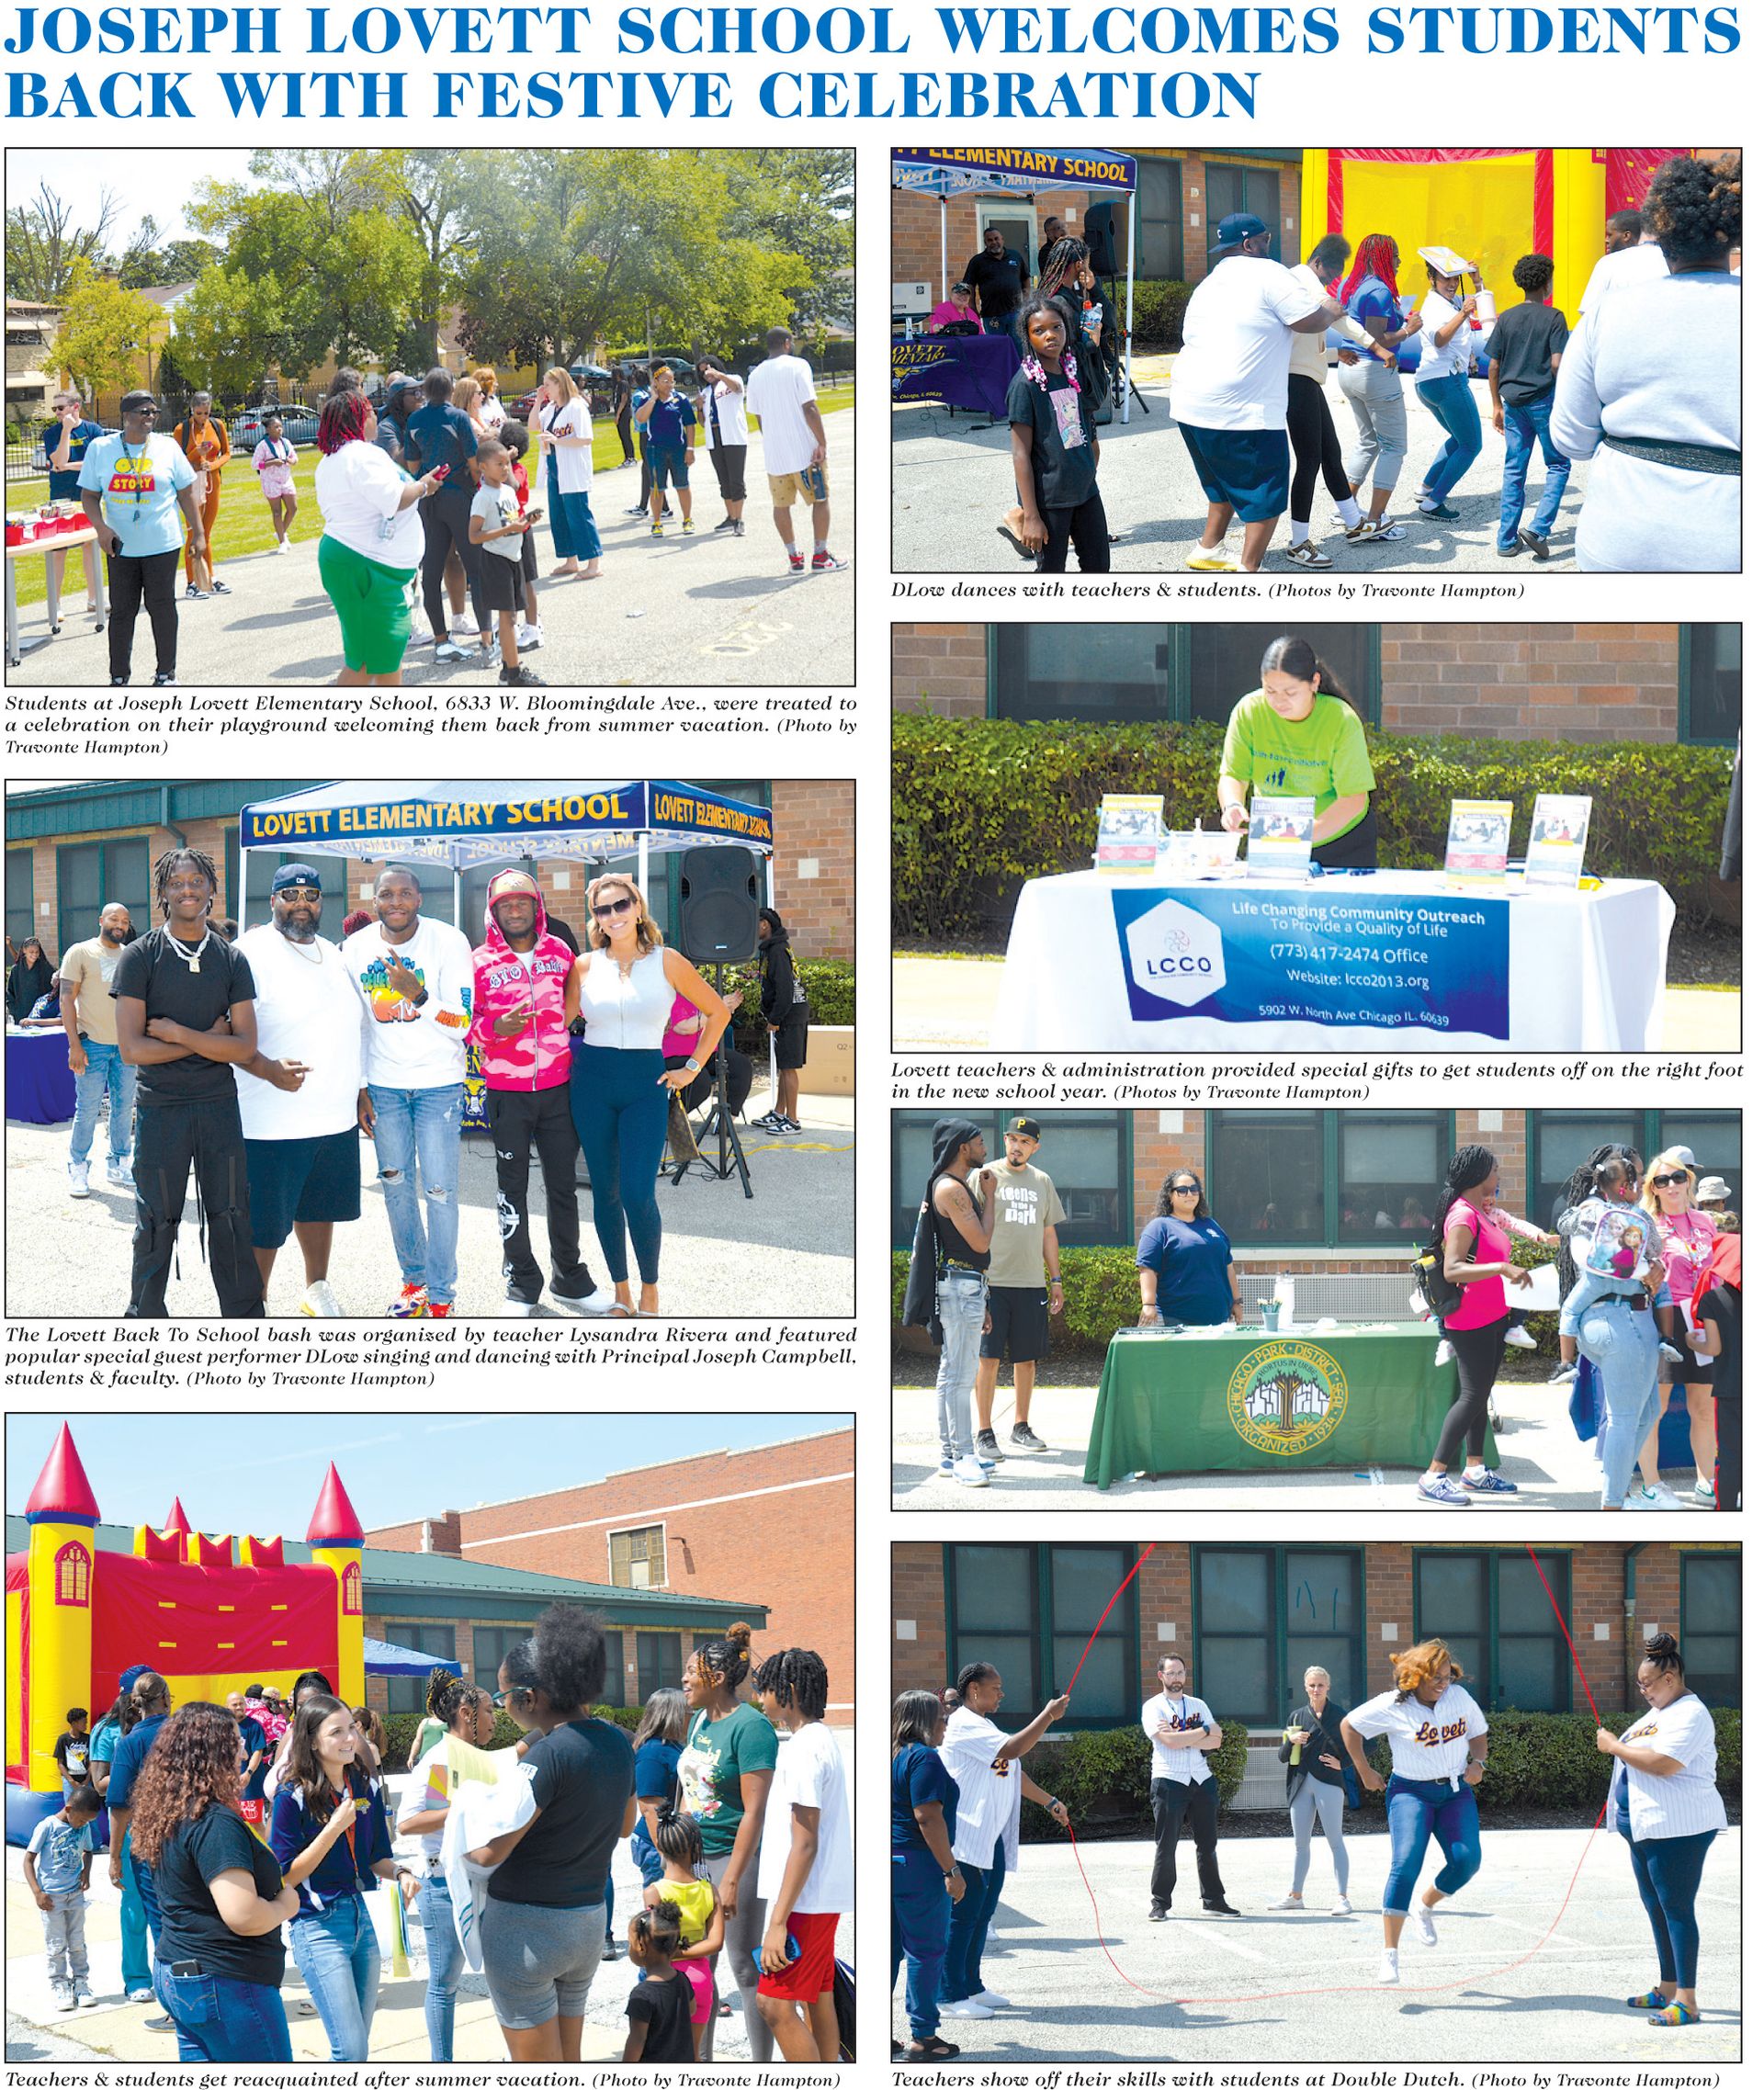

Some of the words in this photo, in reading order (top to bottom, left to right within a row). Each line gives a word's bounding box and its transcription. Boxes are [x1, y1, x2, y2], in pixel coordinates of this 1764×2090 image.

[1063, 157, 1129, 183] SCHOOL
[253, 809, 332, 838] LOVETT
[339, 801, 498, 832] ELEMENTARY
[506, 793, 628, 824] SCHOOL
[654, 793, 695, 823] LOVETT
[695, 801, 751, 833] ELEMENTARY
[1232, 902, 1259, 915] Life
[1261, 903, 1327, 920] Changing
[1330, 906, 1413, 923] Community
[1418, 909, 1486, 925] Outreach
[1271, 918, 1288, 930] To
[1292, 918, 1340, 932] Provide
[1345, 924, 1352, 932] a
[1356, 921, 1403, 938] Quality
[1408, 922, 1422, 935] of
[1423, 923, 1448, 938] Life
[1147, 957, 1212, 976] LCCO
[1383, 949, 1429, 964] Office
[1286, 969, 1341, 986] Website:
[1345, 972, 1430, 990] lcco2013.org
[1259, 1005, 1286, 1016] 5902
[1288, 1005, 1304, 1016] W.
[1306, 1006, 1333, 1021] North
[1335, 1010, 1356, 1021] Ave
[1359, 1010, 1401, 1025] Chicago
[1405, 1011, 1418, 1021] IL.
[1419, 1011, 1449, 1026] 60639
[1017, 1119, 1026, 1129] P
[1000, 1187, 1038, 1203] teens
[1004, 1204, 1036, 1226] park
[1231, 1362, 1253, 1414] CHICAGO
[1254, 1343, 1287, 1363] PARK
[1295, 1344, 1340, 1376] DISTRICT
[1330, 1383, 1344, 1410] SEAL
[1259, 1360, 1288, 1378] HORTUS
[1297, 1361, 1317, 1376] URBE
[1236, 1418, 1307, 1452] ORGANIZED
[1313, 1418, 1336, 1440] 1934
